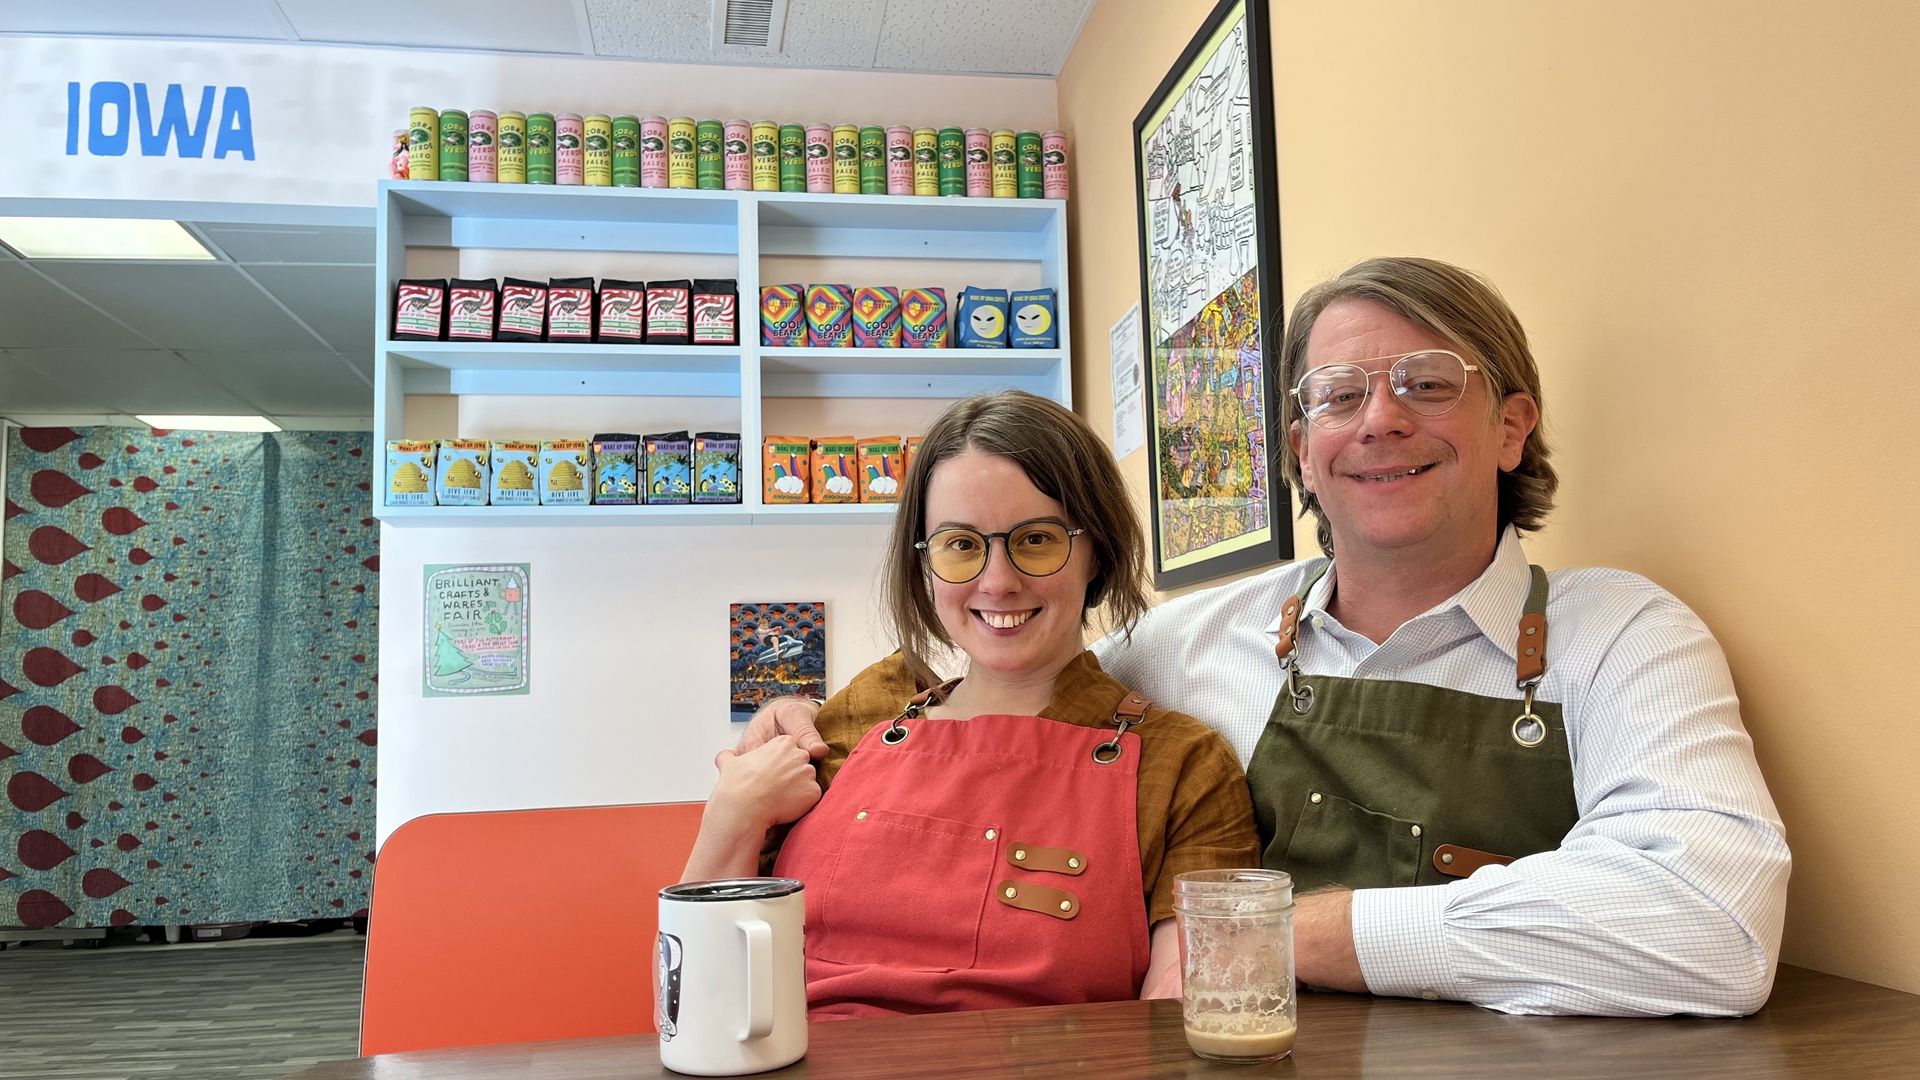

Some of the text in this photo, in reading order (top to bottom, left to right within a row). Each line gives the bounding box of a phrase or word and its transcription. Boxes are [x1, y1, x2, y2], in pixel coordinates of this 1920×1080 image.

[66, 82, 255, 160] IOWA
[774, 321, 800, 329] COOL
[866, 321, 892, 329] COOL
[913, 324, 939, 332] COOL
[436, 578, 499, 589] BRILLIANT
[440, 587, 489, 599] CRAFTS &
[443, 600, 483, 609] WARES
[444, 610, 482, 620] FAIR
